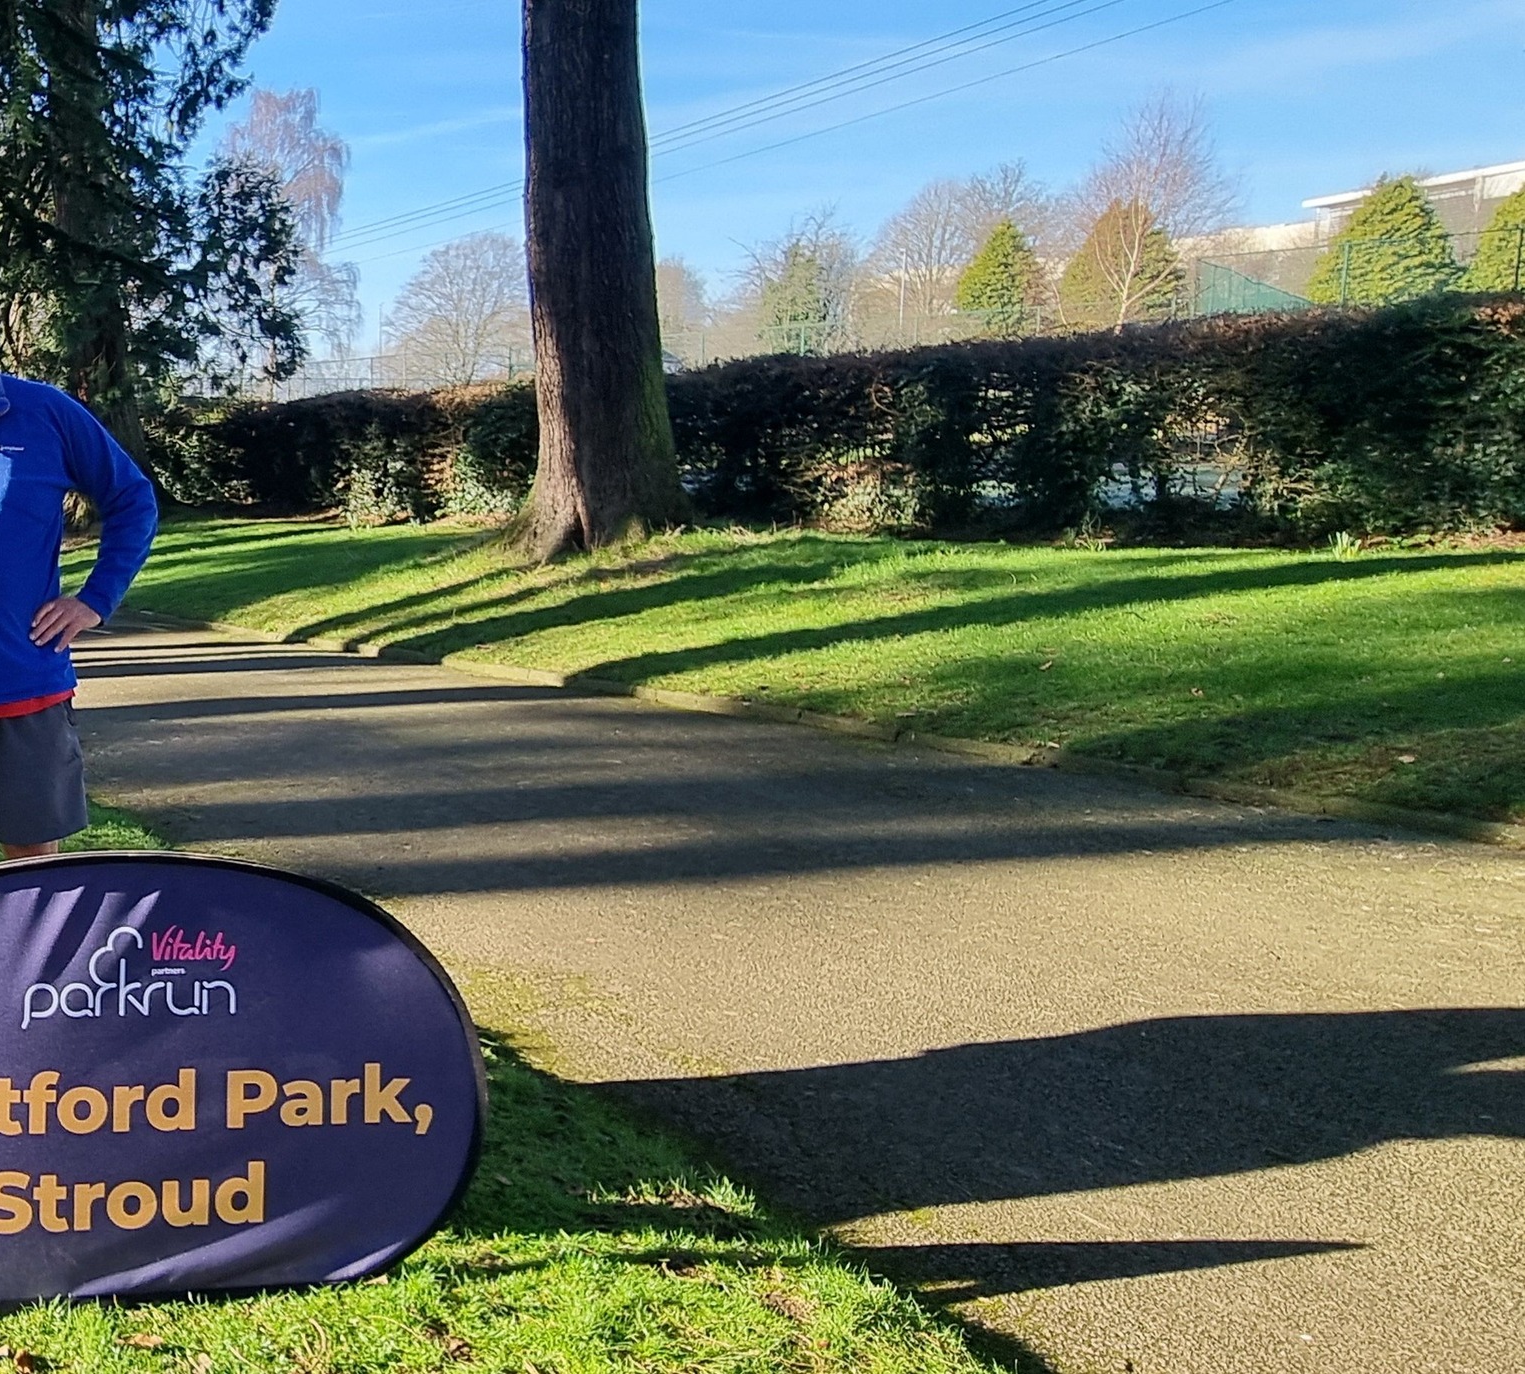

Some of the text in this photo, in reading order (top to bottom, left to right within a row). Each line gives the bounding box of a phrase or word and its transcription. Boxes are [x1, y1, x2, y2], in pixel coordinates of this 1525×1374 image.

[151, 967, 186, 976] partners
[152, 925, 236, 971] Vitality
[21, 950, 237, 1030] parkrun
[226, 1063, 433, 1135] Park,
